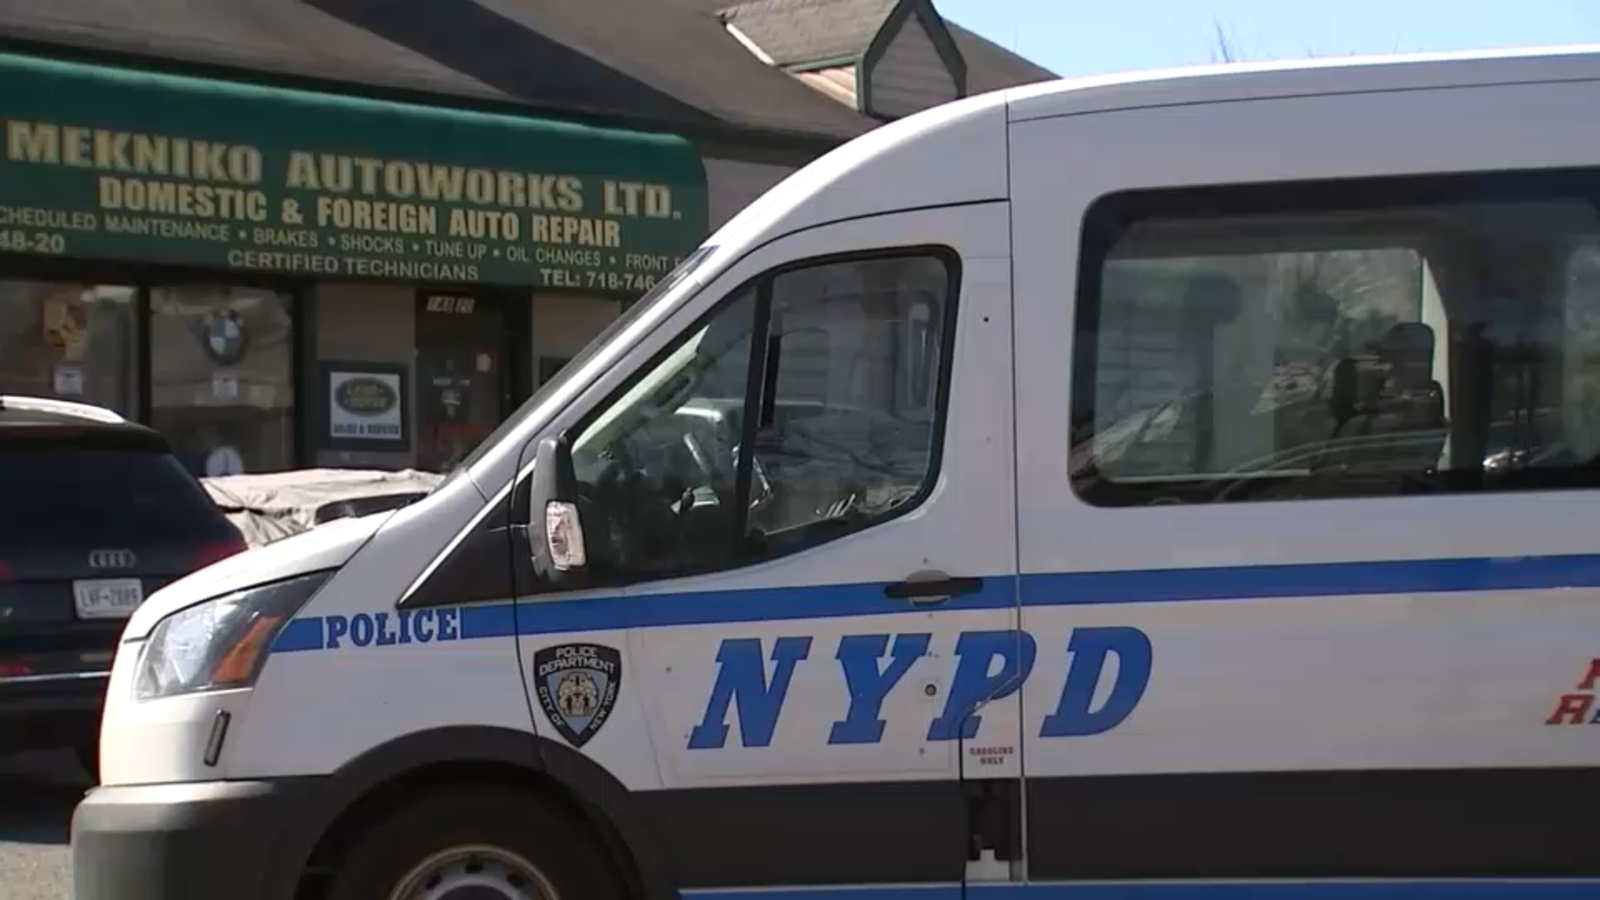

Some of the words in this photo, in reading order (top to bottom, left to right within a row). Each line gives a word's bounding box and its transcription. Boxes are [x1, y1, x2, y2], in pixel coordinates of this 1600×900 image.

[7, 119, 262, 185] MEKNIKO
[287, 151, 583, 212] AUTOWORKS
[604, 181, 681, 219] LTD.
[100, 177, 267, 221] DOMESTIC
[282, 198, 304, 225] &
[317, 196, 436, 234] FOREIGN
[449, 209, 519, 240] AUTO
[532, 214, 620, 247] REPAIR
[105, 214, 229, 241] MAINTENANCE
[254, 227, 318, 247] BRAKES
[341, 234, 404, 254] SHOCKS
[425, 240, 464, 258] TUNE
[468, 244, 487, 259] UP
[507, 246, 528, 262] OIL
[535, 248, 600, 266] CHANGES
[626, 253, 668, 271] FRONT
[227, 250, 338, 273] CERTIFIED
[345, 258, 478, 281] TECHNICIANS
[541, 268, 580, 287] TEL:
[325, 608, 458, 650] POLICE
[539, 656, 615, 676] DEPARTMENT
[556, 646, 598, 658] POLICE
[539, 685, 552, 711] CITY
[551, 713, 565, 726] OF
[590, 710, 607, 731] NEW
[604, 680, 617, 708] YORK
[687, 626, 1152, 750] NYPD
[969, 746, 1014, 756] GASOLINE
[980, 756, 1004, 766] ONLY
